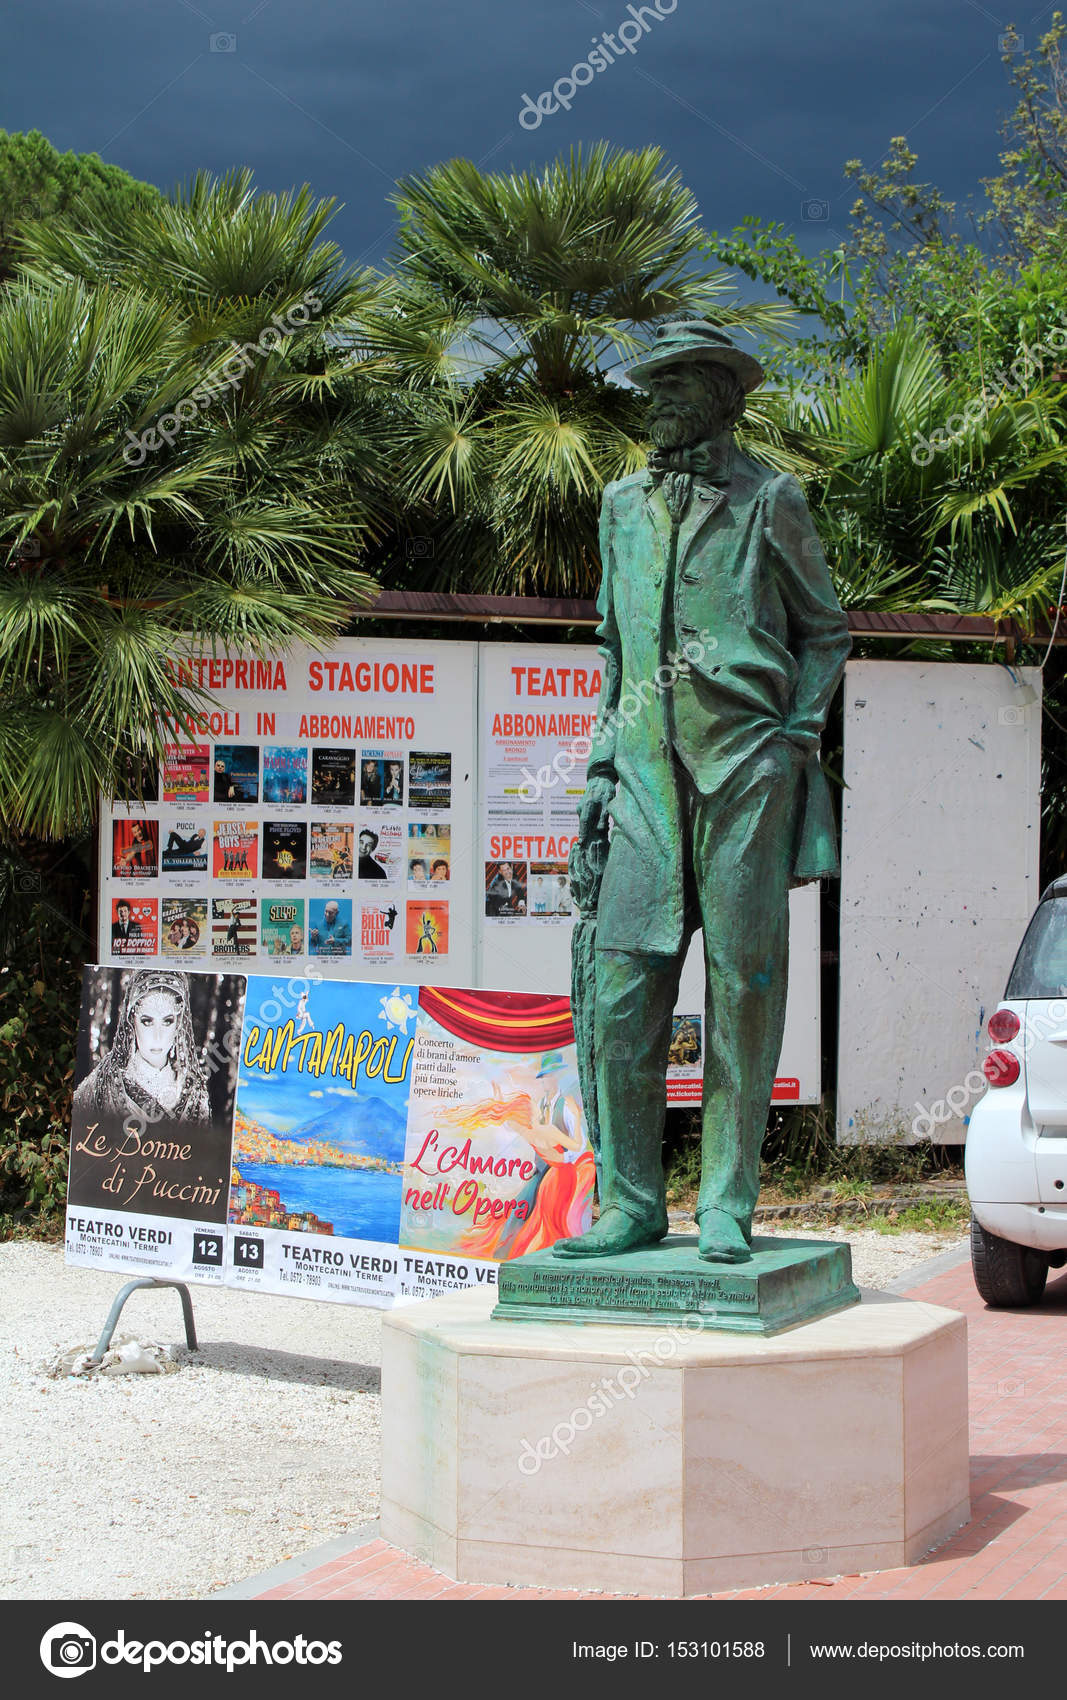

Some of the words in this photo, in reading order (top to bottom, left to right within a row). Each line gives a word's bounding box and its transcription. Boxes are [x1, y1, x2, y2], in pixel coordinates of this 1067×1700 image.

[309, 661, 435, 694] STAGIONE
[257, 712, 276, 736] IN
[299, 714, 415, 740] ABBONAMENTO
[176, 822, 195, 830] PUCCI
[217, 823, 247, 835] JERSEY
[219, 836, 240, 848] BOYS
[361, 914, 385, 929] BILLY
[361, 930, 390, 945] ELLIOT
[418, 1036, 454, 1048] Concerto
[244, 1019, 415, 1089] CANTANAPOLI
[416, 1048, 425, 1058] di
[427, 1049, 447, 1060] brani
[449, 1050, 481, 1063] d'amore
[416, 1062, 435, 1071] tratti
[437, 1063, 456, 1073] dalle
[415, 1073, 428, 1084] più
[430, 1074, 457, 1085] famose
[413, 1087, 436, 1097] opere
[437, 1087, 463, 1099] liriche
[76, 1123, 111, 1157] Le
[109, 1127, 192, 1162] Donne
[410, 1129, 537, 1181] L'Amore
[102, 1163, 126, 1194] di
[123, 1164, 225, 1206] Puccini
[68, 1217, 123, 1237] TEATRO
[129, 1226, 172, 1245] VERDI
[80, 1233, 130, 1248] MONTECATINI
[134, 1242, 159, 1252] TERME
[198, 1240, 217, 1256] 12
[240, 1243, 259, 1260] 13
[282, 1244, 344, 1266] TEATRO
[349, 1254, 398, 1275] VERDI
[295, 1262, 351, 1277] MONTECATINI
[356, 1270, 384, 1282] TERME
[404, 1258, 468, 1280] TEATRO
